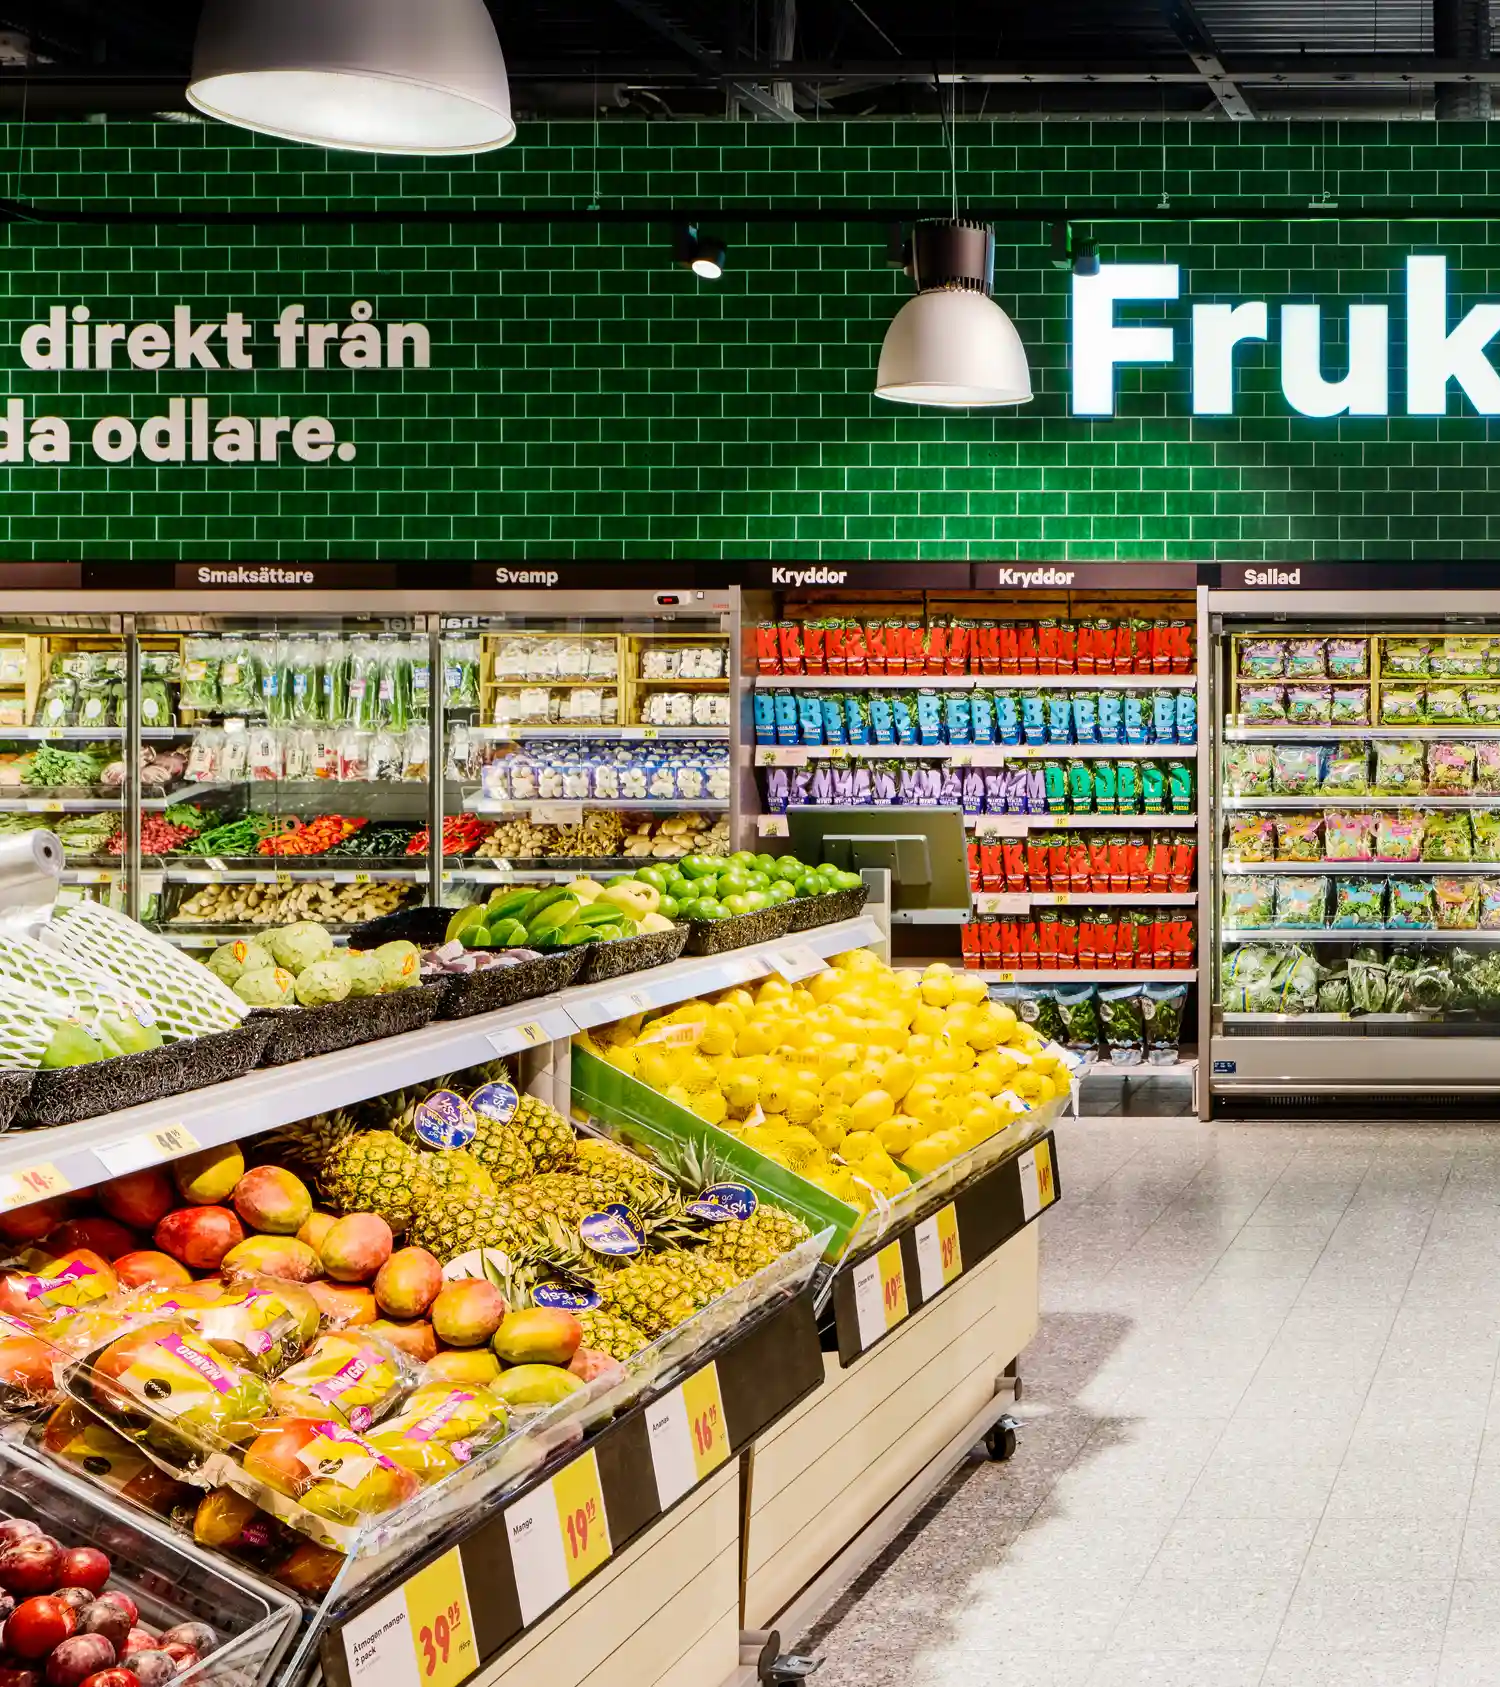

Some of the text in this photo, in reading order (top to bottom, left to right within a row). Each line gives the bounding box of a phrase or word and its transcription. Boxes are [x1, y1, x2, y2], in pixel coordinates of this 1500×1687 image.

[20, 300, 431, 370] direkt från
[92, 397, 357, 463] odlare.
[198, 566, 315, 585] Smaksättare
[496, 568, 559, 588] Svamp
[772, 567, 848, 589] Kryddor
[999, 568, 1075, 590] Kryddor
[1244, 568, 1301, 586] Sallad
[775, 695, 797, 725] B
[870, 700, 891, 730] B
[972, 700, 992, 730] B
[1073, 699, 1094, 729] B
[1099, 697, 1121, 727] B
[812, 769, 832, 797] M
[1027, 770, 1046, 798] M
[1003, 844, 1026, 874] K
[175, 1345, 224, 1381] MANGO
[652, 1415, 669, 1432] Ananas
[694, 1411, 713, 1456] 16
[512, 1517, 533, 1536] Mango
[566, 1508, 588, 1559] 19
[383, 1612, 406, 1634] mango,
[360, 1646, 377, 1665] pack
[419, 1614, 450, 1677] 39
